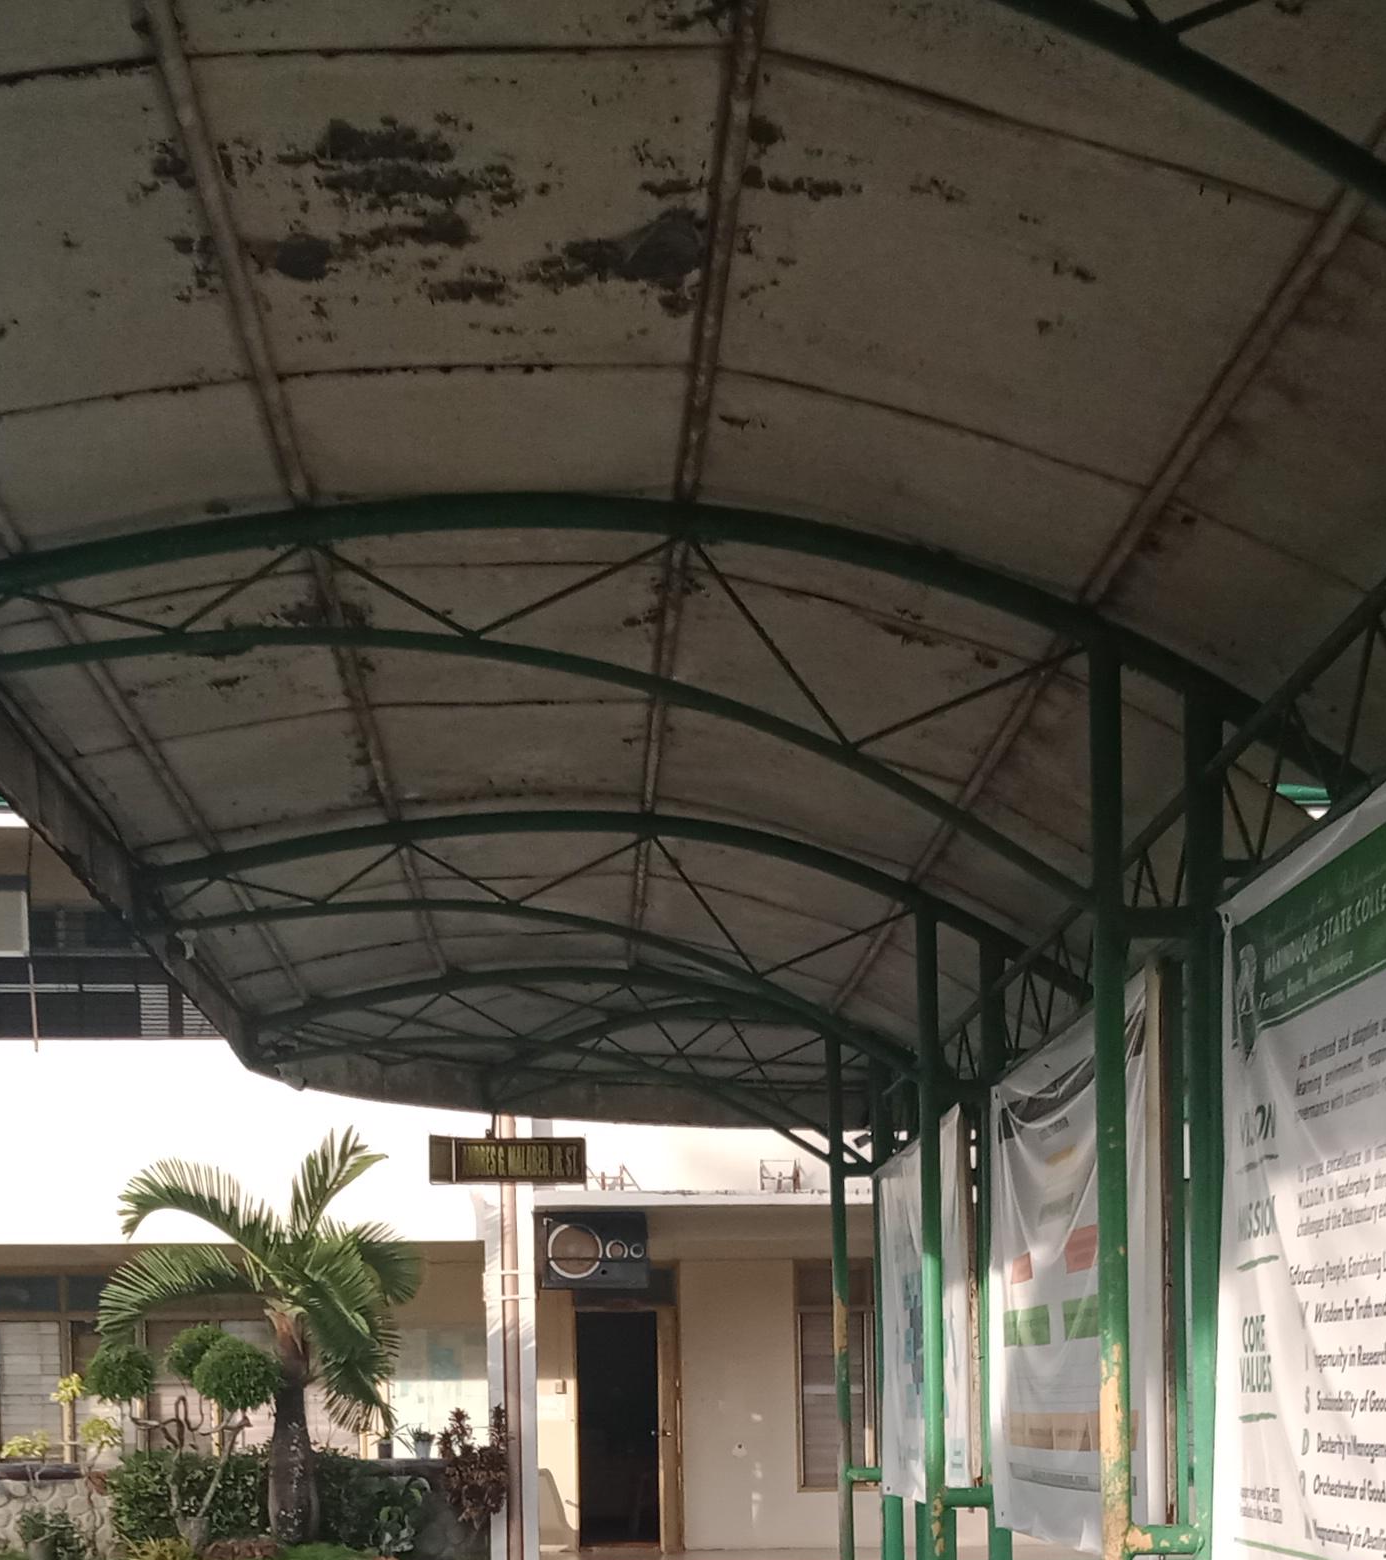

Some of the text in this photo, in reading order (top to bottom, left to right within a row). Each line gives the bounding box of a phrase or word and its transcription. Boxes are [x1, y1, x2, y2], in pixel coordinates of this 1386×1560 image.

[1242, 1314, 1266, 1353] CORE
[1240, 1354, 1272, 1393] VALUES
[1368, 1480, 1386, 1503] Good
